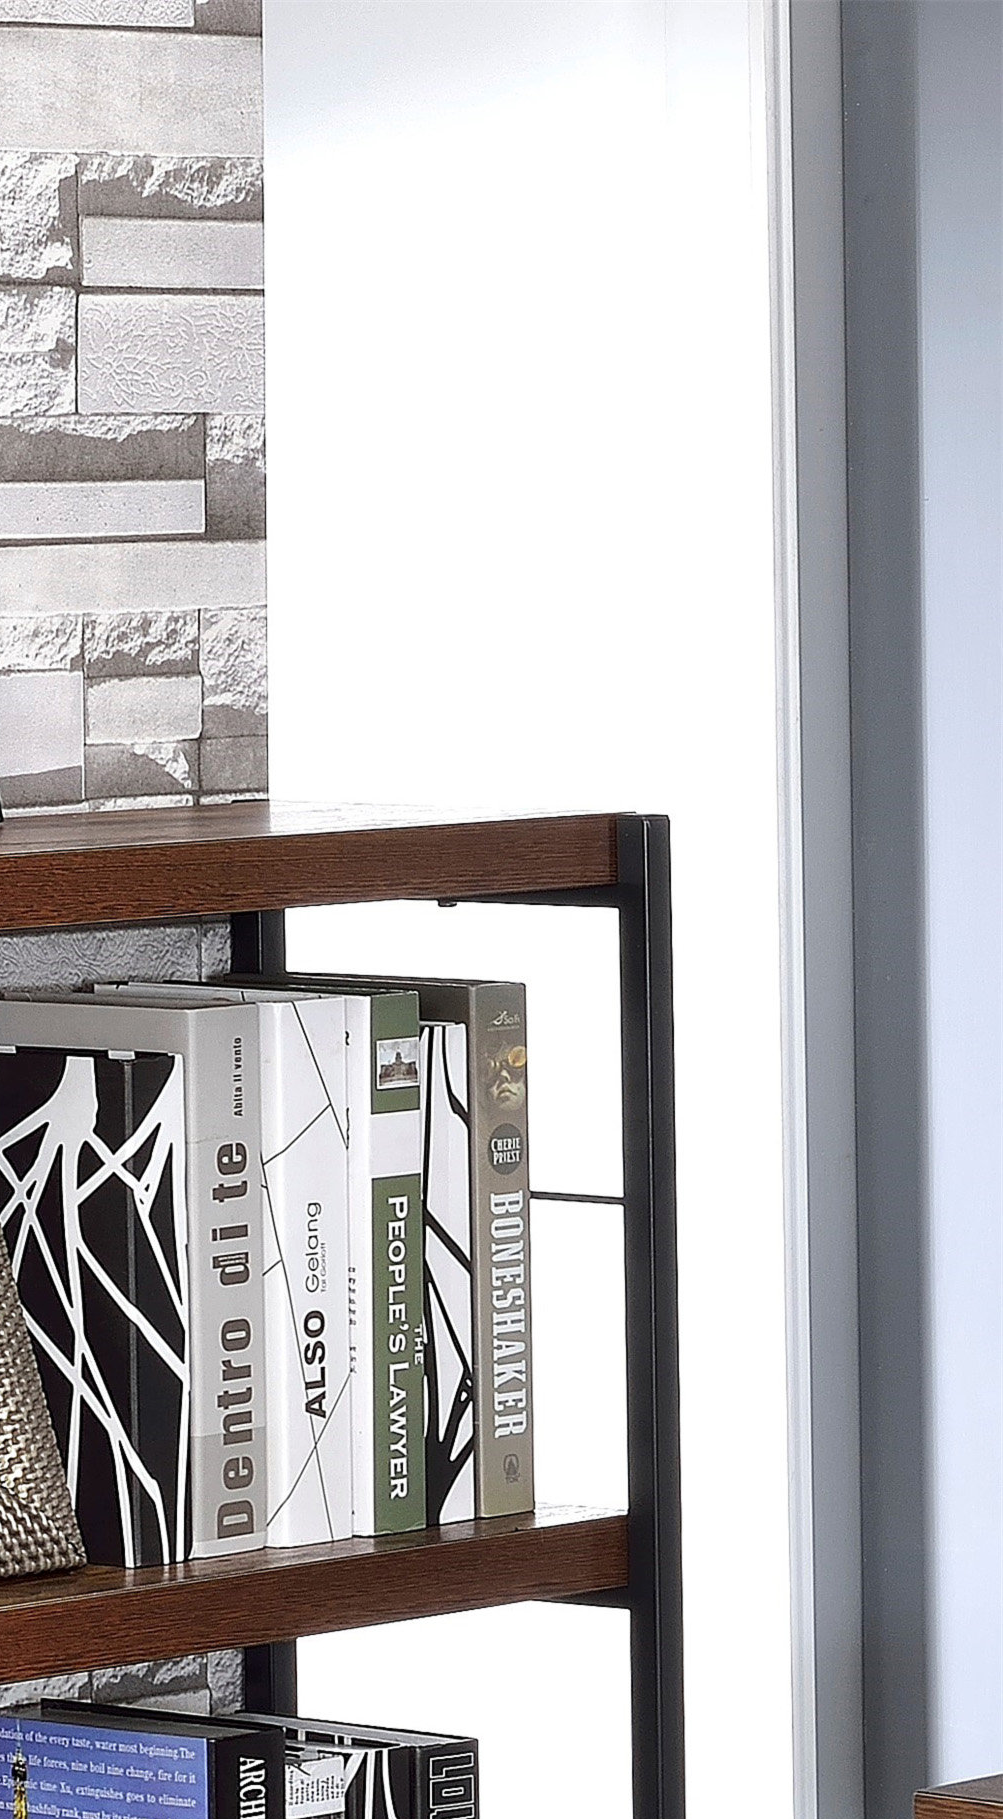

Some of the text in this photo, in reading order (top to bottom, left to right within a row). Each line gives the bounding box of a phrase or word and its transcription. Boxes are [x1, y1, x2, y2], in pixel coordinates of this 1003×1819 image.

[233, 1037, 242, 1069] vento
[491, 1137, 521, 1152] CHERIE
[492, 1150, 521, 1166] PRIEST
[305, 1202, 322, 1293] Gelang
[489, 1190, 528, 1439] BONESHAKER
[211, 1142, 255, 1540] Dentro di te
[387, 1195, 410, 1500] PEOPLE'S LAWYER
[413, 1324, 424, 1365] THE
[303, 1310, 327, 1419] ALSO
[25, 1731, 35, 1742] of
[35, 1731, 48, 1743] the
[49, 1735, 71, 1748] every
[72, 1737, 93, 1750] taste,
[95, 1740, 117, 1752] water
[118, 1742, 138, 1754] most
[28, 1754, 42, 1766] life
[43, 1756, 69, 1771] forces,
[71, 1760, 88, 1772] nine
[90, 1761, 106, 1773] boil
[107, 1763, 124, 1776] nine
[126, 1766, 156, 1781] change,
[158, 1769, 172, 1782] fire
[174, 1770, 187, 1783] for
[40, 1780, 196, 1808] time extinguishes goes to eliminate
